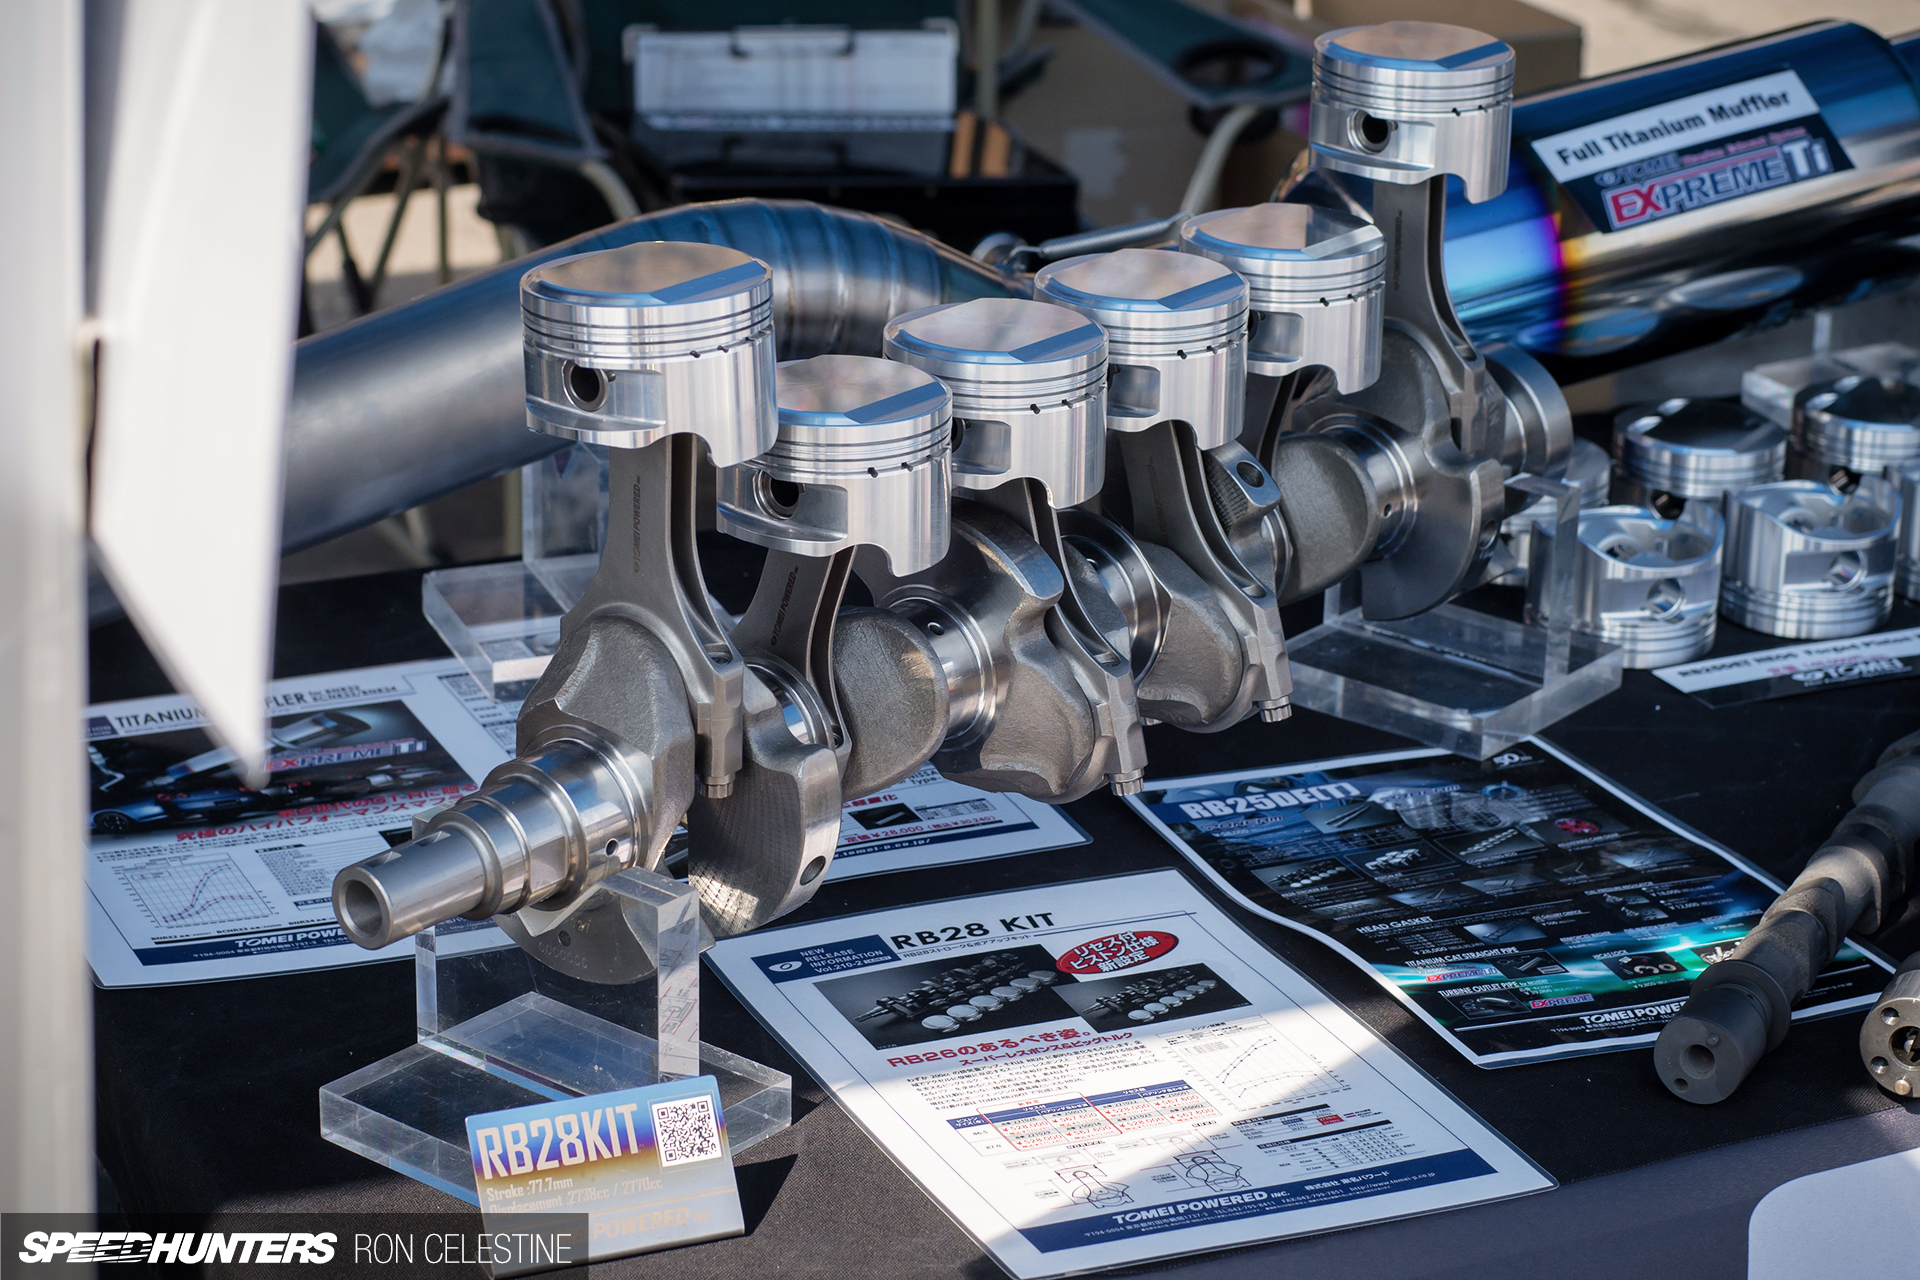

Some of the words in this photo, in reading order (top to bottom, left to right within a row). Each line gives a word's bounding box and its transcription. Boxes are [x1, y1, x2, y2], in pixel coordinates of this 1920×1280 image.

[1556, 139, 1603, 167] Full
[1603, 113, 1706, 151] Titanium
[1706, 90, 1790, 126] Muffler
[780, 571, 797, 613] POWERED
[890, 922, 990, 950] RB28
[999, 912, 1055, 932] KIT
[1356, 923, 1390, 934] HEAD
[1390, 915, 1434, 929] GASKET
[235, 931, 294, 948] TOMEI
[295, 926, 346, 943] POWE
[1073, 930, 1138, 957] リセス付
[800, 947, 825, 957] NEW
[805, 948, 855, 963] RELEASE
[810, 949, 884, 968] INFORMATION
[1070, 935, 1160, 970] ピストン仕様
[1097, 950, 1150, 972] 新設定
[1405, 956, 1446, 968] TITANIUM
[1444, 953, 1461, 962] CAT
[1461, 948, 1503, 961] STRAIGHT
[1502, 946, 1520, 955] PIPE
[814, 960, 864, 974] Vol.210-2
[1438, 986, 1472, 998] TURBINE
[1472, 983, 1501, 993] OUTLET
[1500, 980, 1520, 989] PIPE
[1580, 1010, 1636, 1025] TOMEI
[1636, 1000, 1688, 1017] POWE
[887, 1028, 1091, 1068] RB26のあるべき姿。
[476, 1102, 639, 1181] RB28KIT
[486, 1184, 524, 1203] Stroke
[1112, 1206, 1174, 1225] TOMEI
[1177, 1190, 1268, 1214] POWERED
[1270, 1191, 1291, 1199] INC.
[593, 1206, 690, 1241] POWERED
